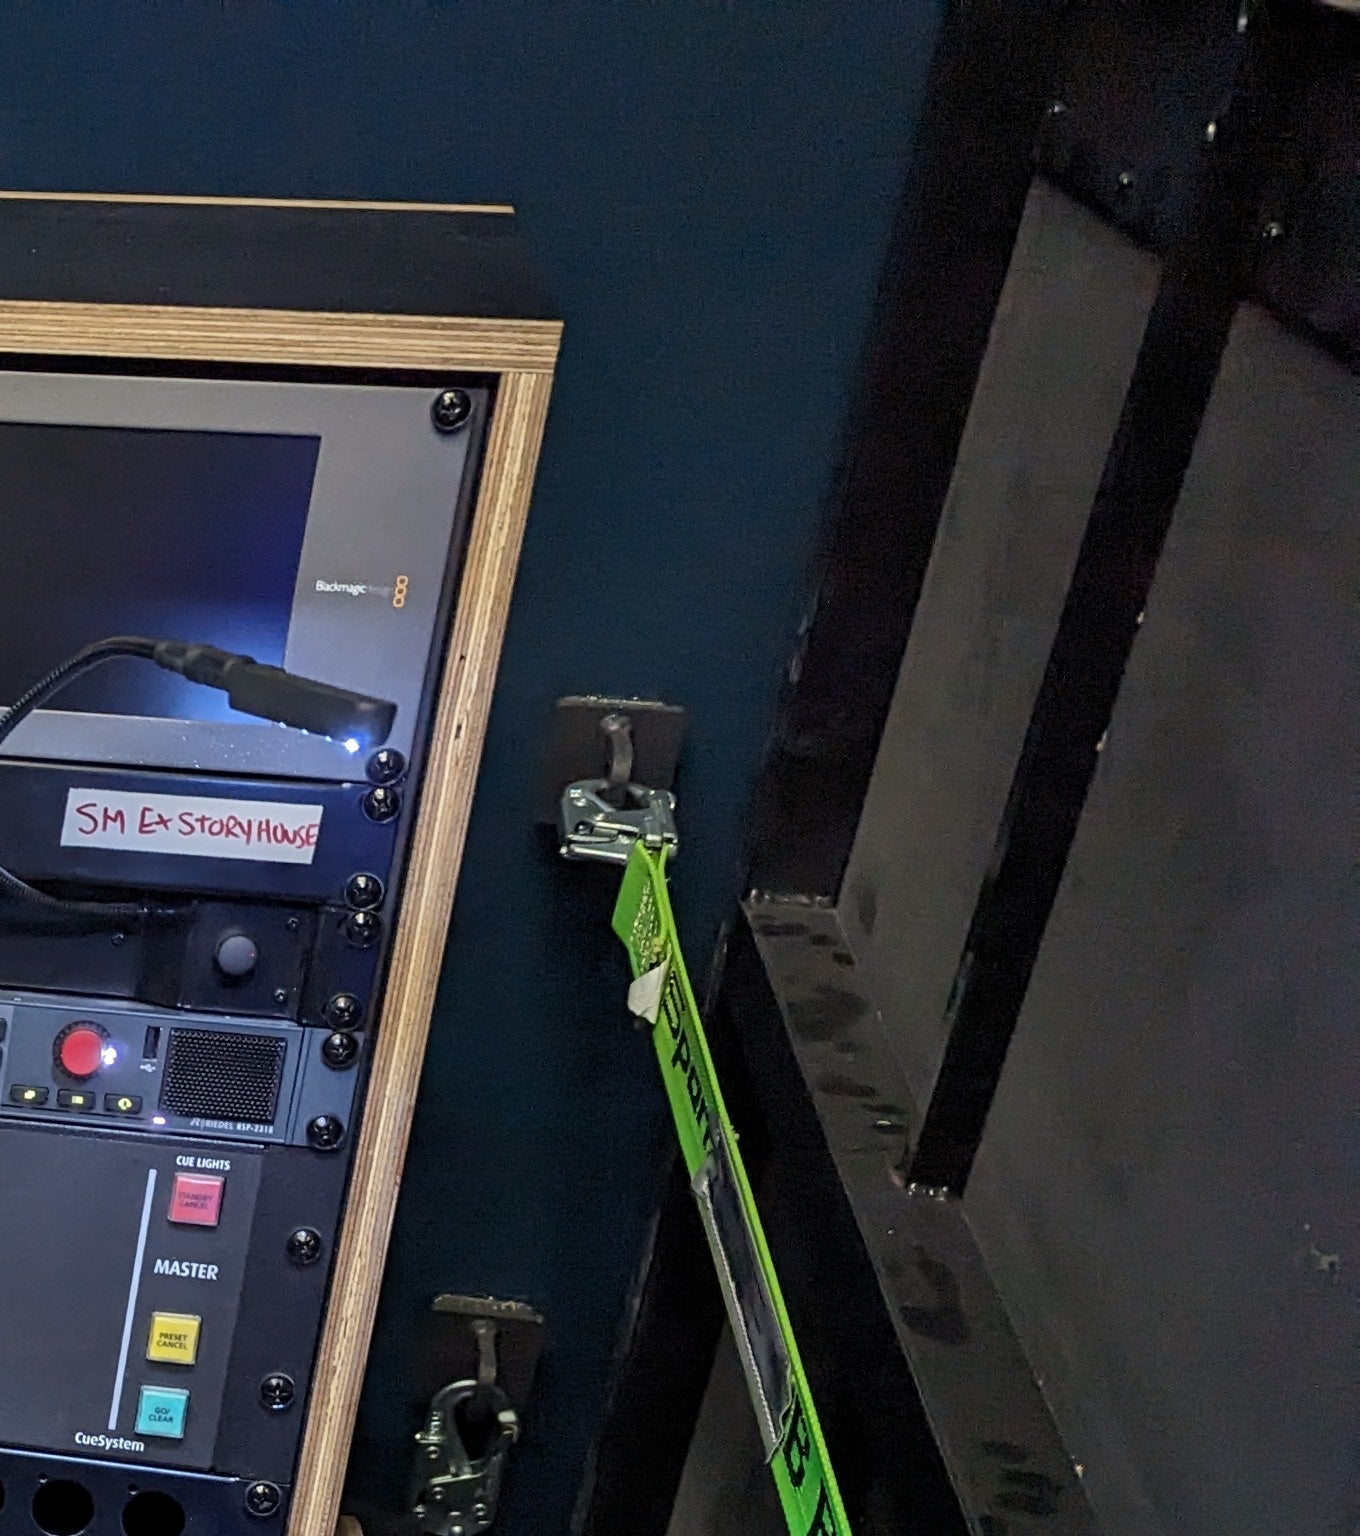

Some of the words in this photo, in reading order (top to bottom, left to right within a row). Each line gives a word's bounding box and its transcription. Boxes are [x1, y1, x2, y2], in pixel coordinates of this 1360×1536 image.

[315, 579, 367, 597] Blackmagic
[76, 803, 125, 835] SM
[205, 1120, 233, 1131] RIEDEL
[176, 1155, 194, 1167] CUE
[197, 1157, 231, 1171] LIGHTS
[153, 1258, 220, 1281] MASTER
[156, 1339, 188, 1350] CANCEL
[158, 1331, 188, 1342] PRESET
[148, 1413, 174, 1424] CLEAR
[74, 1431, 145, 1453] CueSystem
